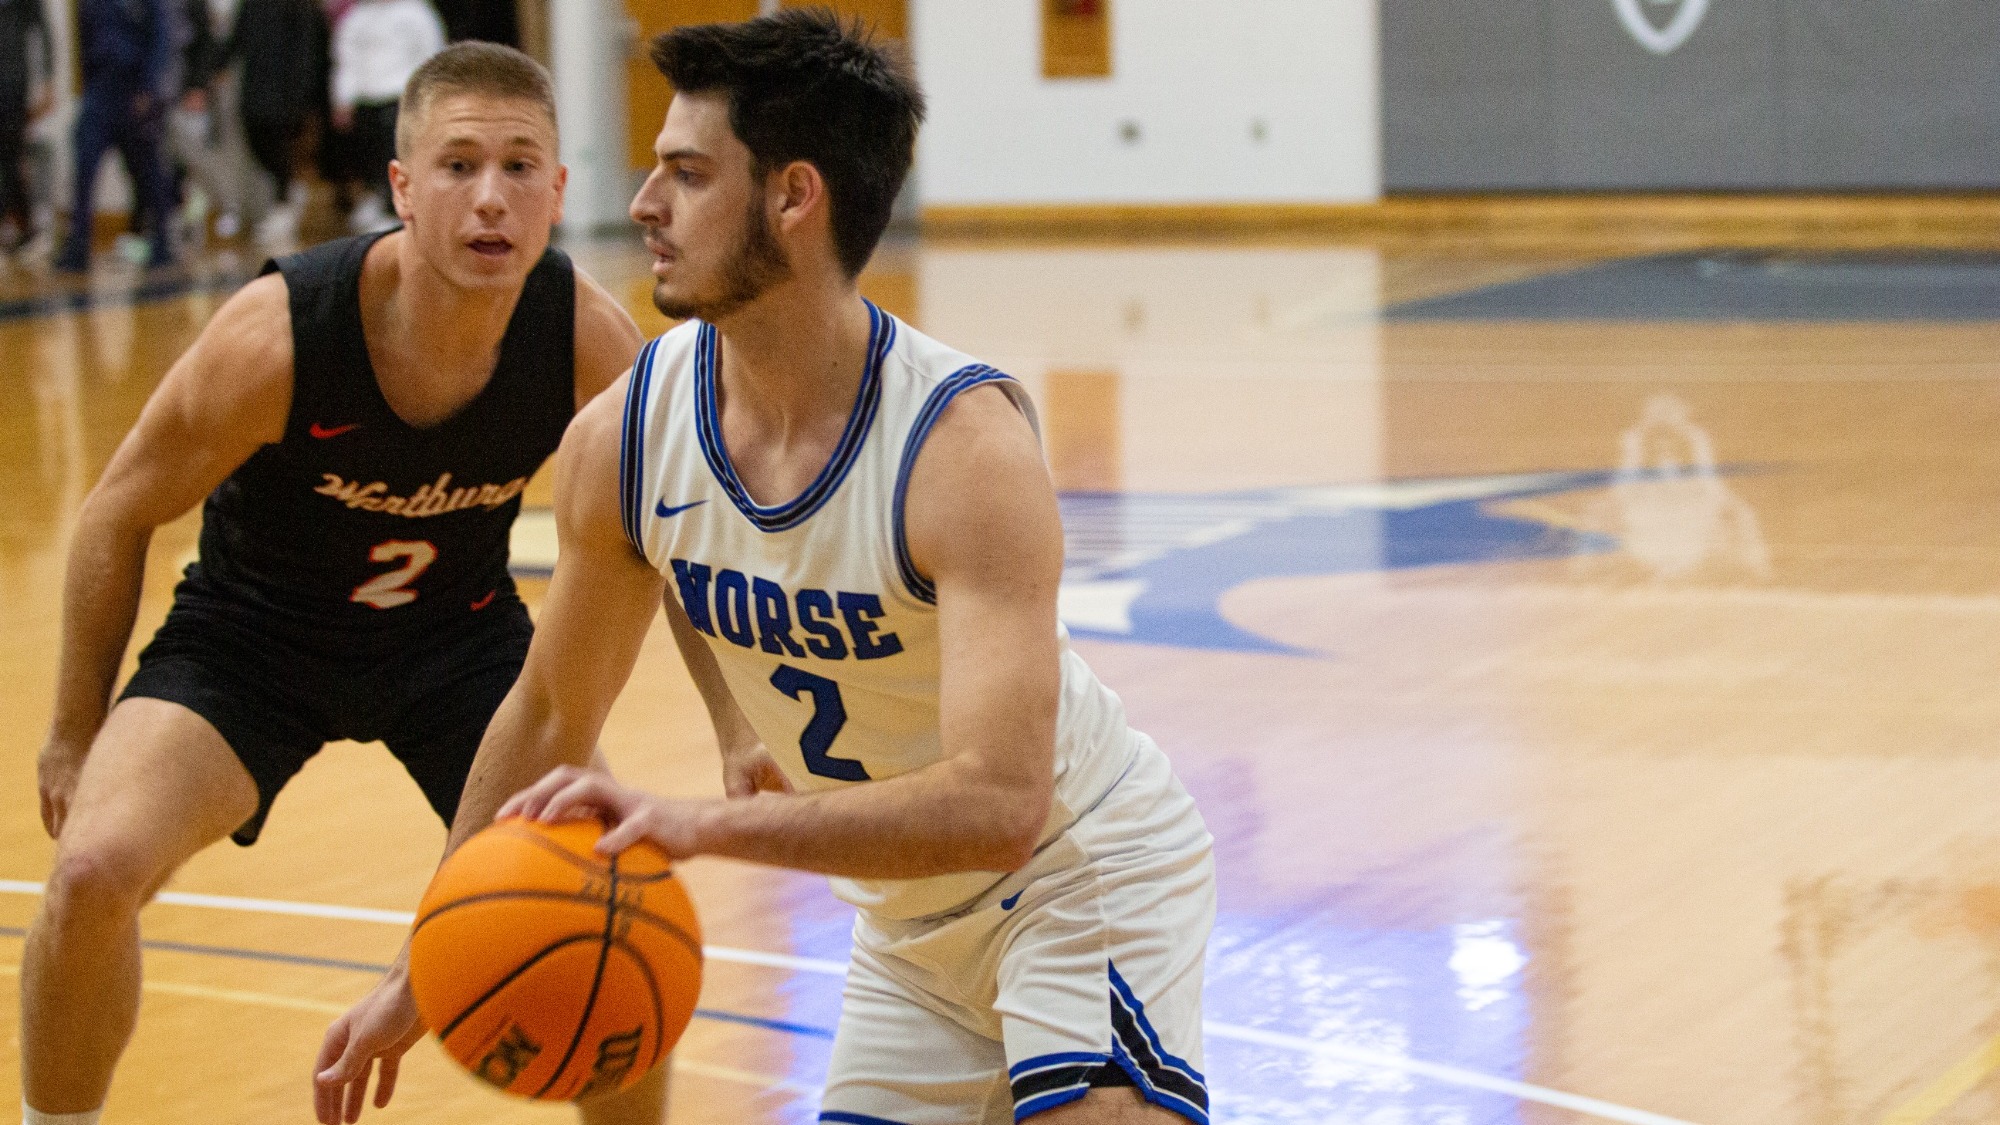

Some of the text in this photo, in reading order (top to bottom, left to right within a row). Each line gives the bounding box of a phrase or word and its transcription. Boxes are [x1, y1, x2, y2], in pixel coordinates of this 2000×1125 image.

[350, 538, 438, 609] 2
[669, 557, 904, 660] NORSE
[769, 662, 872, 782] 2
